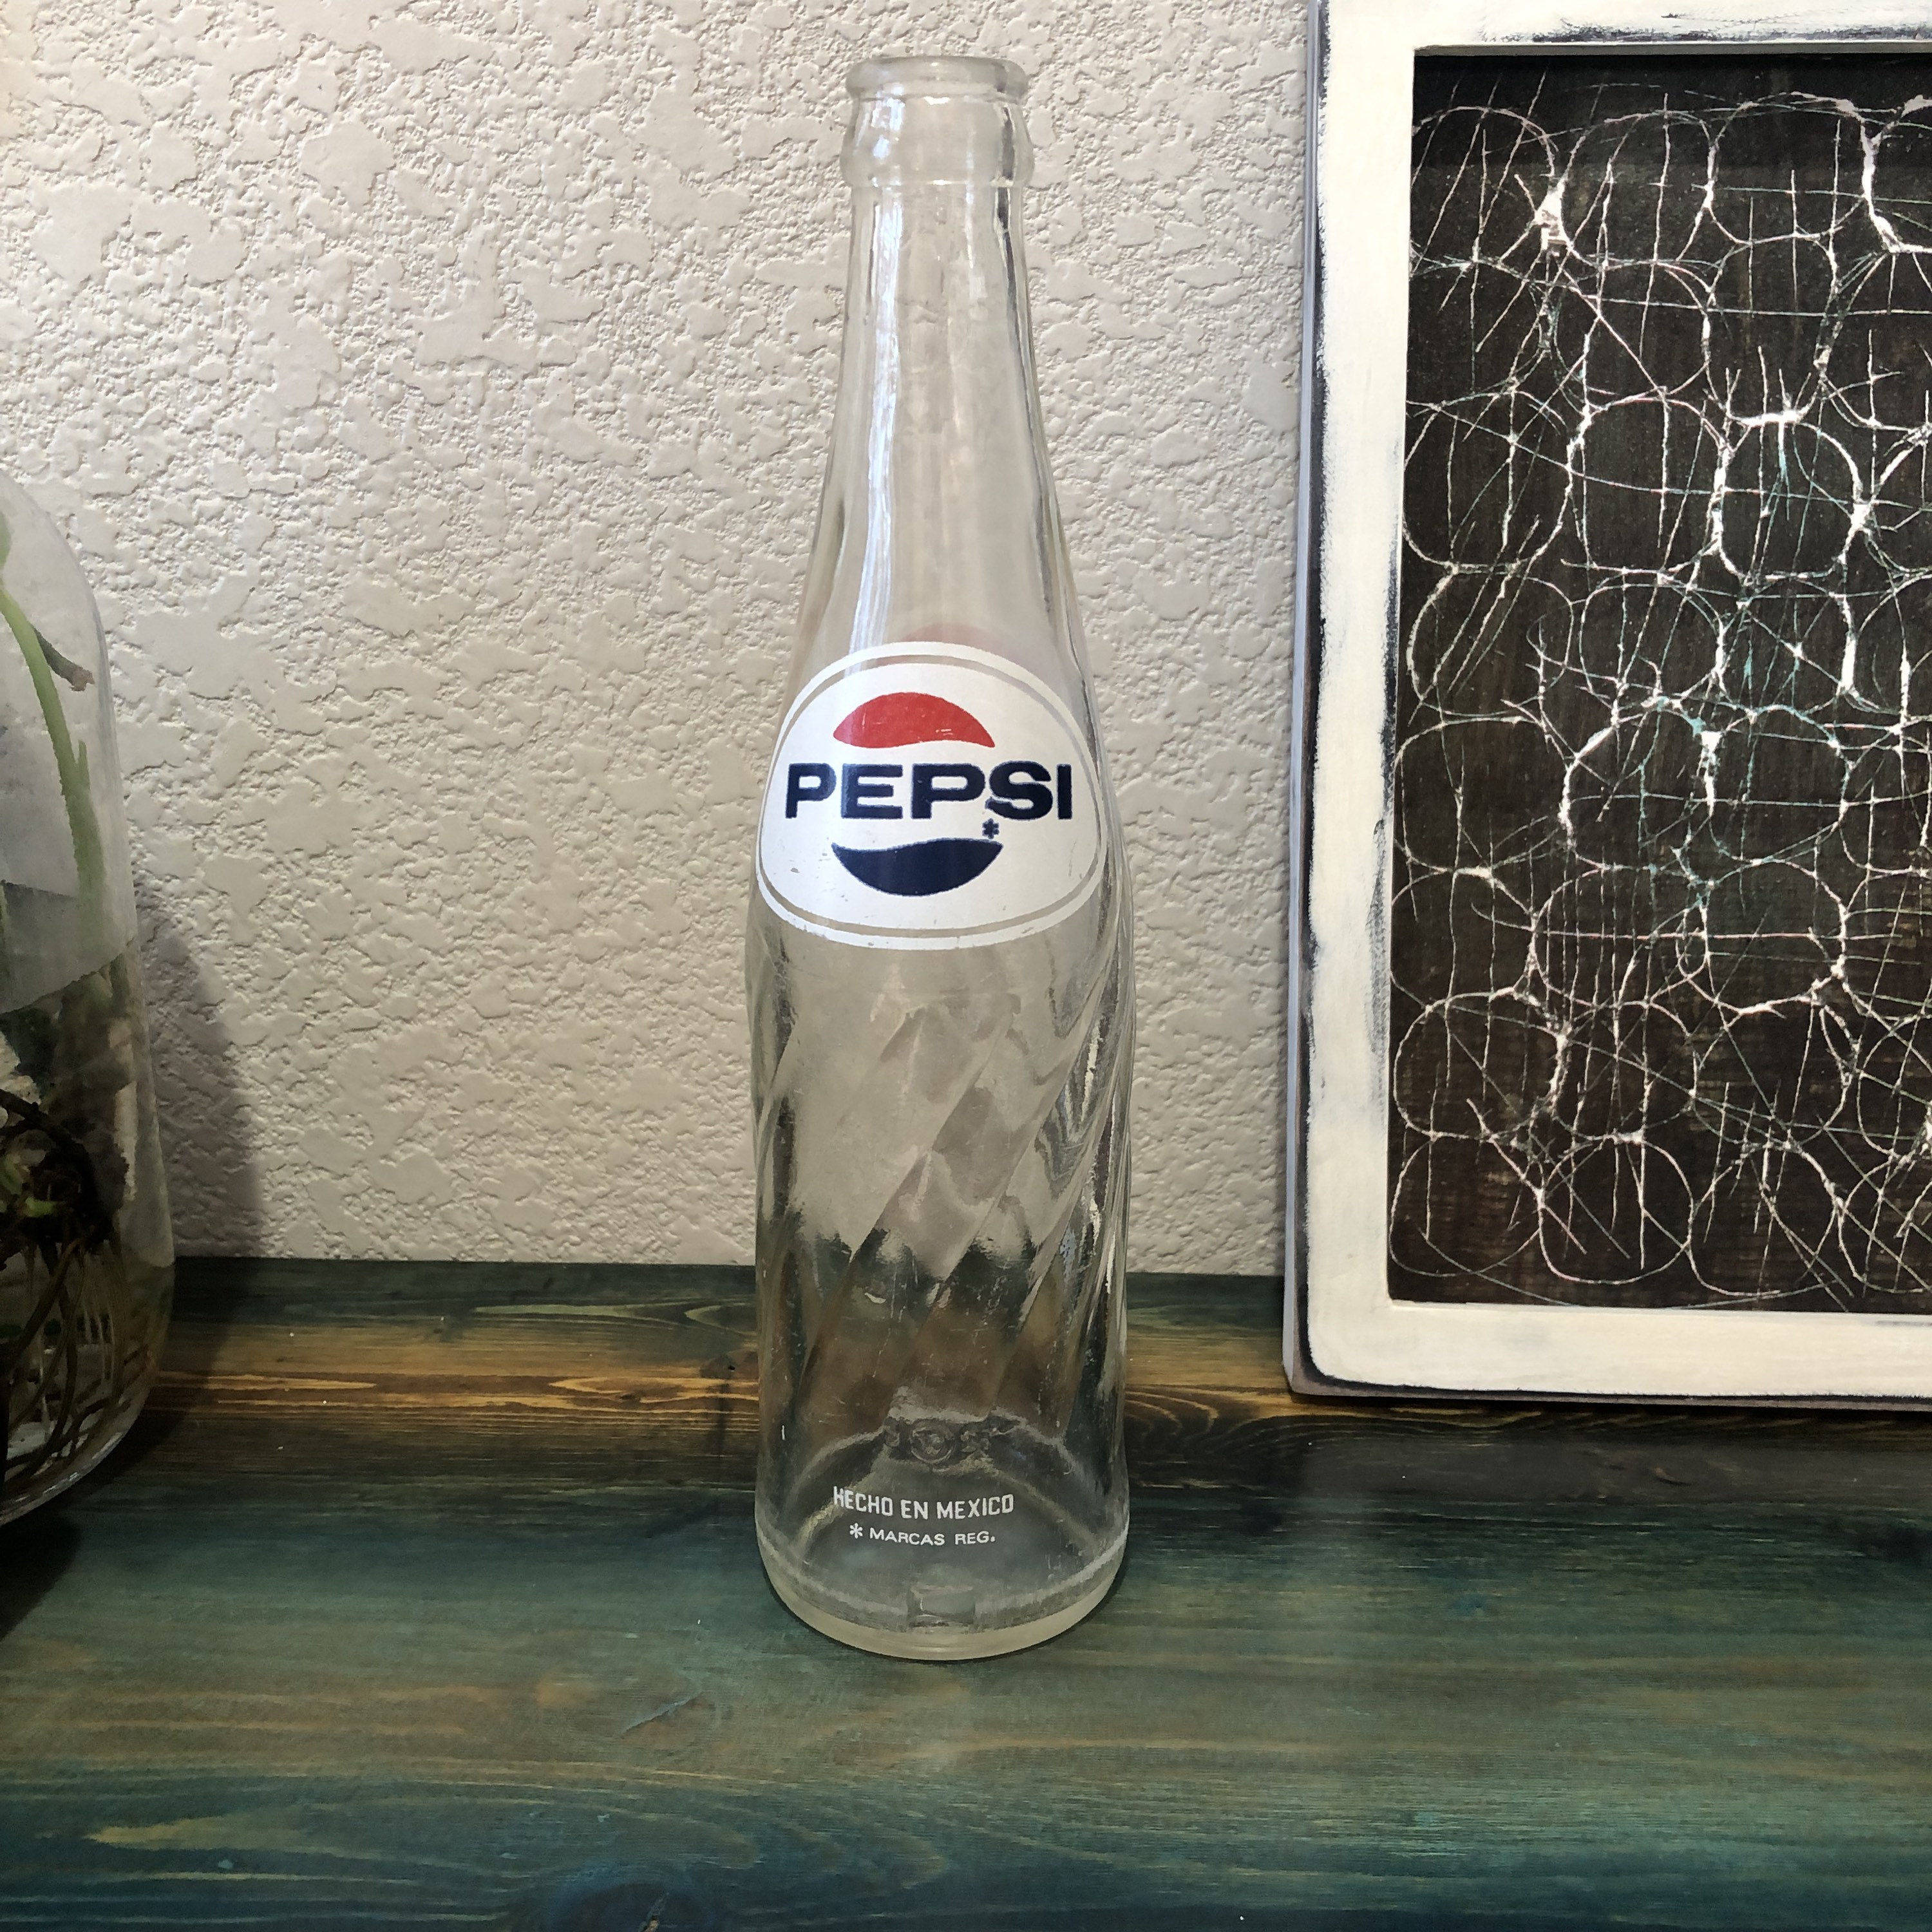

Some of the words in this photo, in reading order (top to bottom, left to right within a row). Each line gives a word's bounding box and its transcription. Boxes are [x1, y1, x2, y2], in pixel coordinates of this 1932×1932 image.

[786, 760, 1072, 821] PEPSI
[833, 1486, 893, 1517] HECHO
[901, 1499, 929, 1520] EN
[936, 1494, 1014, 1520] MEXICO
[869, 1527, 945, 1546] MARCAS
[954, 1530, 996, 1545] REG.
